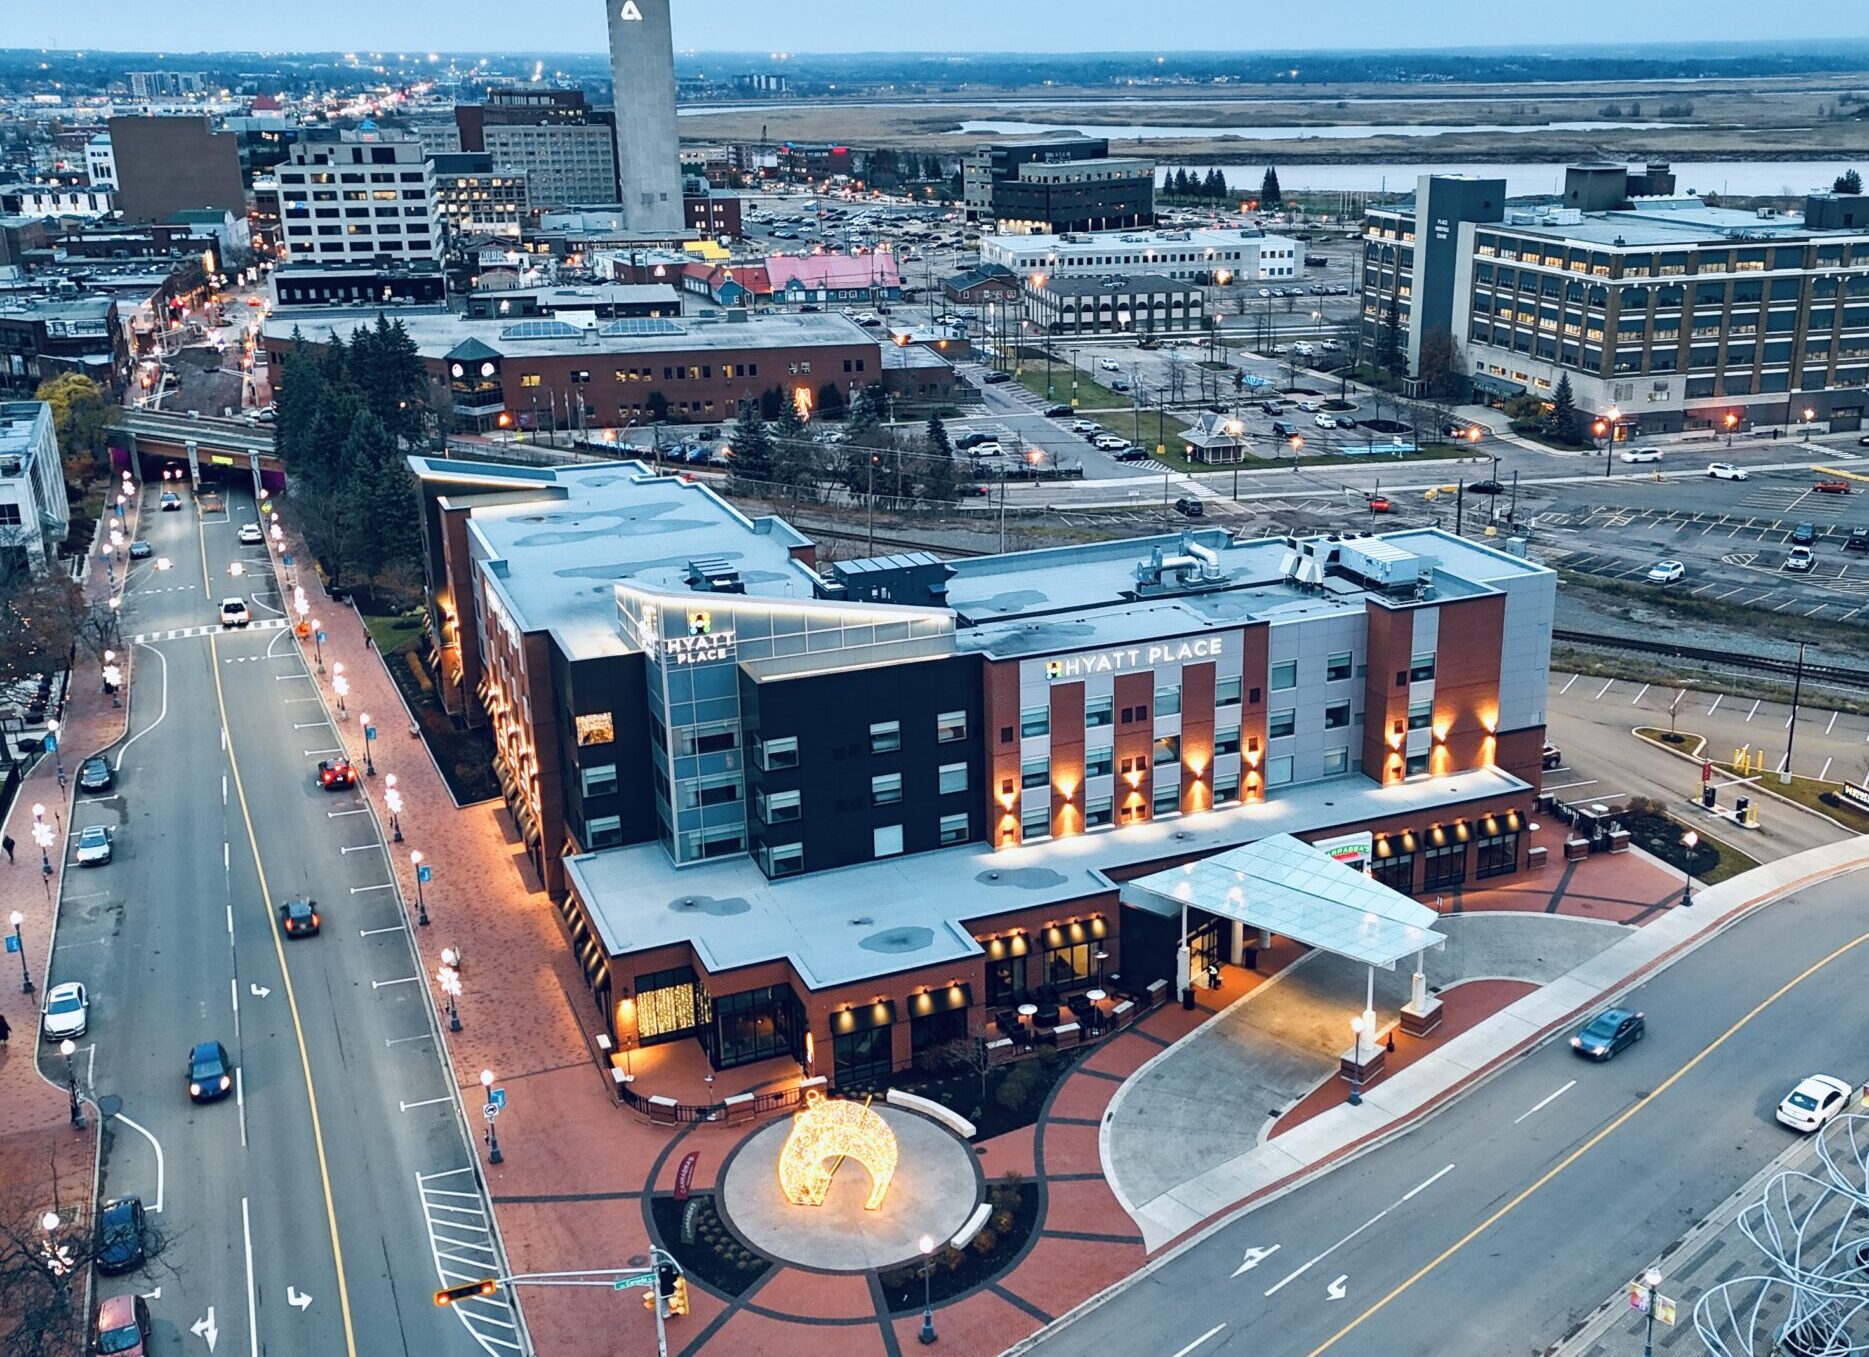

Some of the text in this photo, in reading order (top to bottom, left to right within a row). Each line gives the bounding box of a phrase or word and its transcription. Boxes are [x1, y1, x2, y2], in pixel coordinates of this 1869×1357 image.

[667, 631, 736, 654] HYATT
[677, 648, 727, 665] PLACE
[1065, 637, 1223, 677] HYATT PLACE
